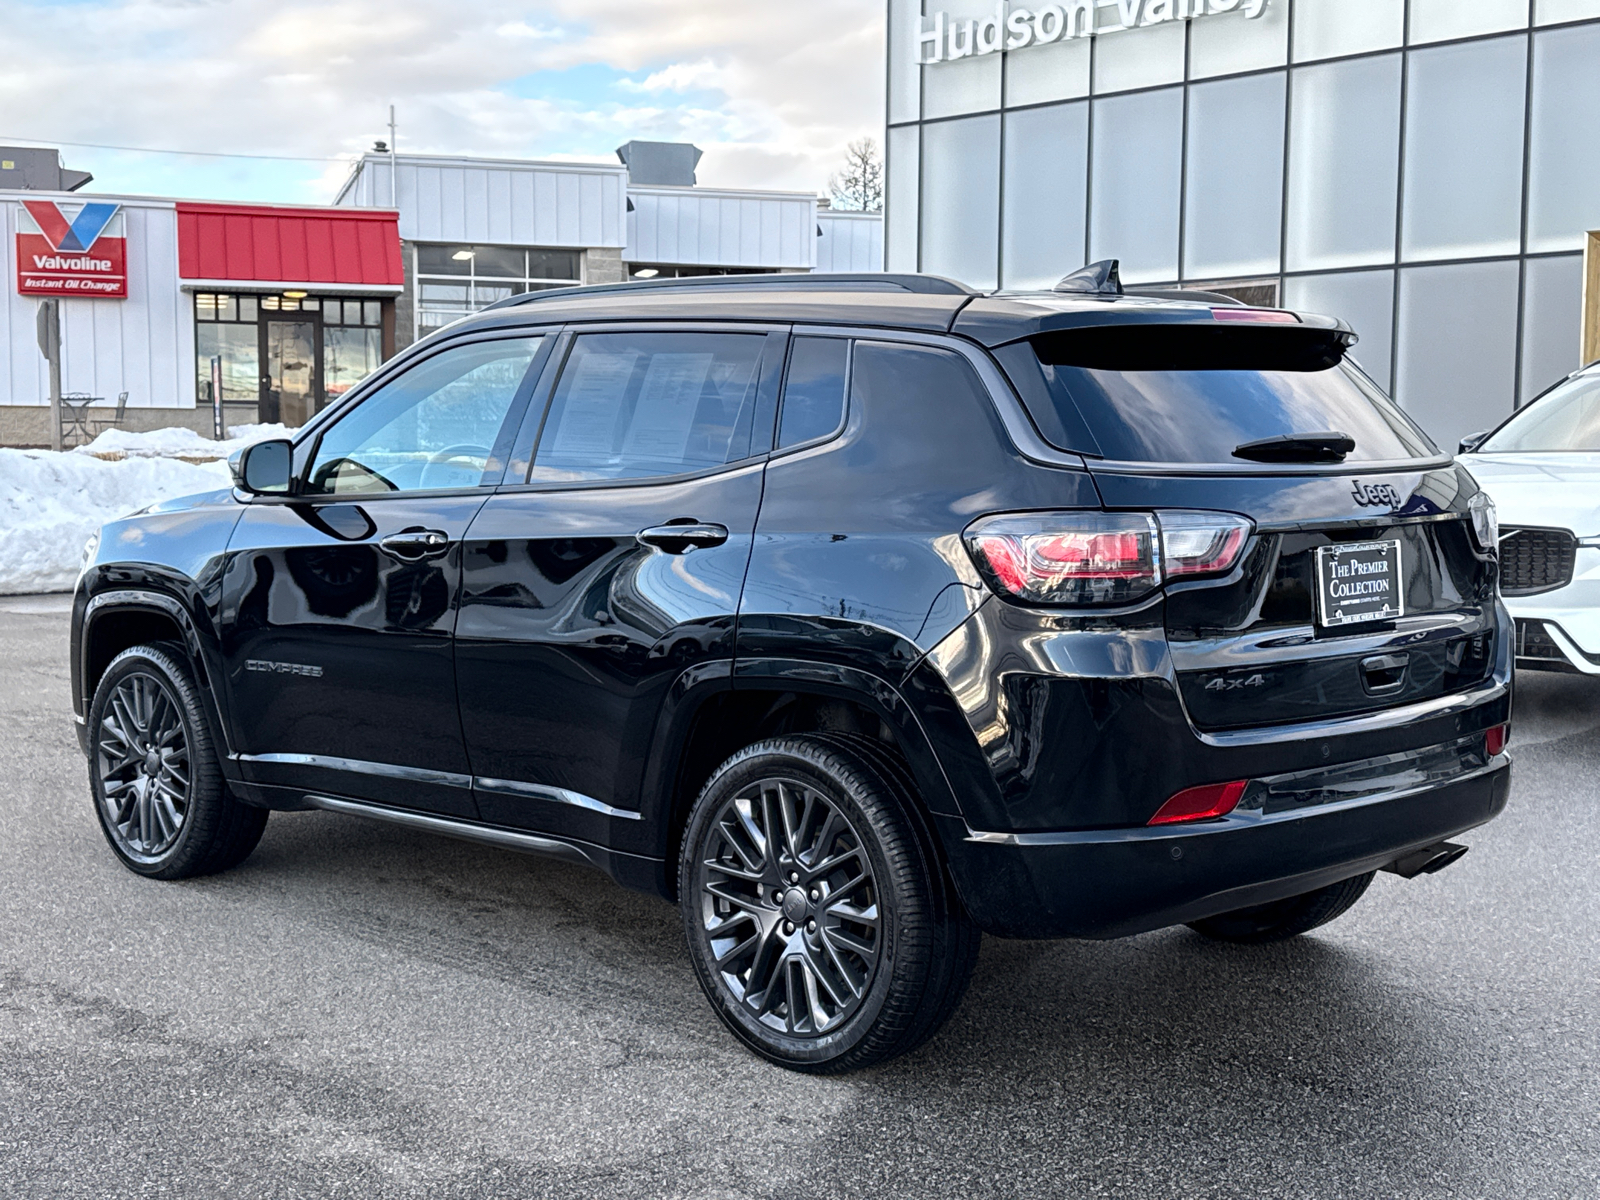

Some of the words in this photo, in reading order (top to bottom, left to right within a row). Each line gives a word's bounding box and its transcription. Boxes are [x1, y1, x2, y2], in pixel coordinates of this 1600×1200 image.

[914, 0, 1097, 64] Hudson
[1116, 0, 1271, 28] Vay
[32, 255, 112, 271] Valvoline
[25, 278, 63, 288] Instant
[65, 280, 79, 289] Oil
[80, 280, 121, 292] Change
[1351, 480, 1401, 511] Jeep
[1329, 561, 1350, 578] THE
[1350, 559, 1389, 576] PREMIER
[1329, 578, 1389, 598] COLLECTION
[1204, 674, 1265, 691] 4x4
